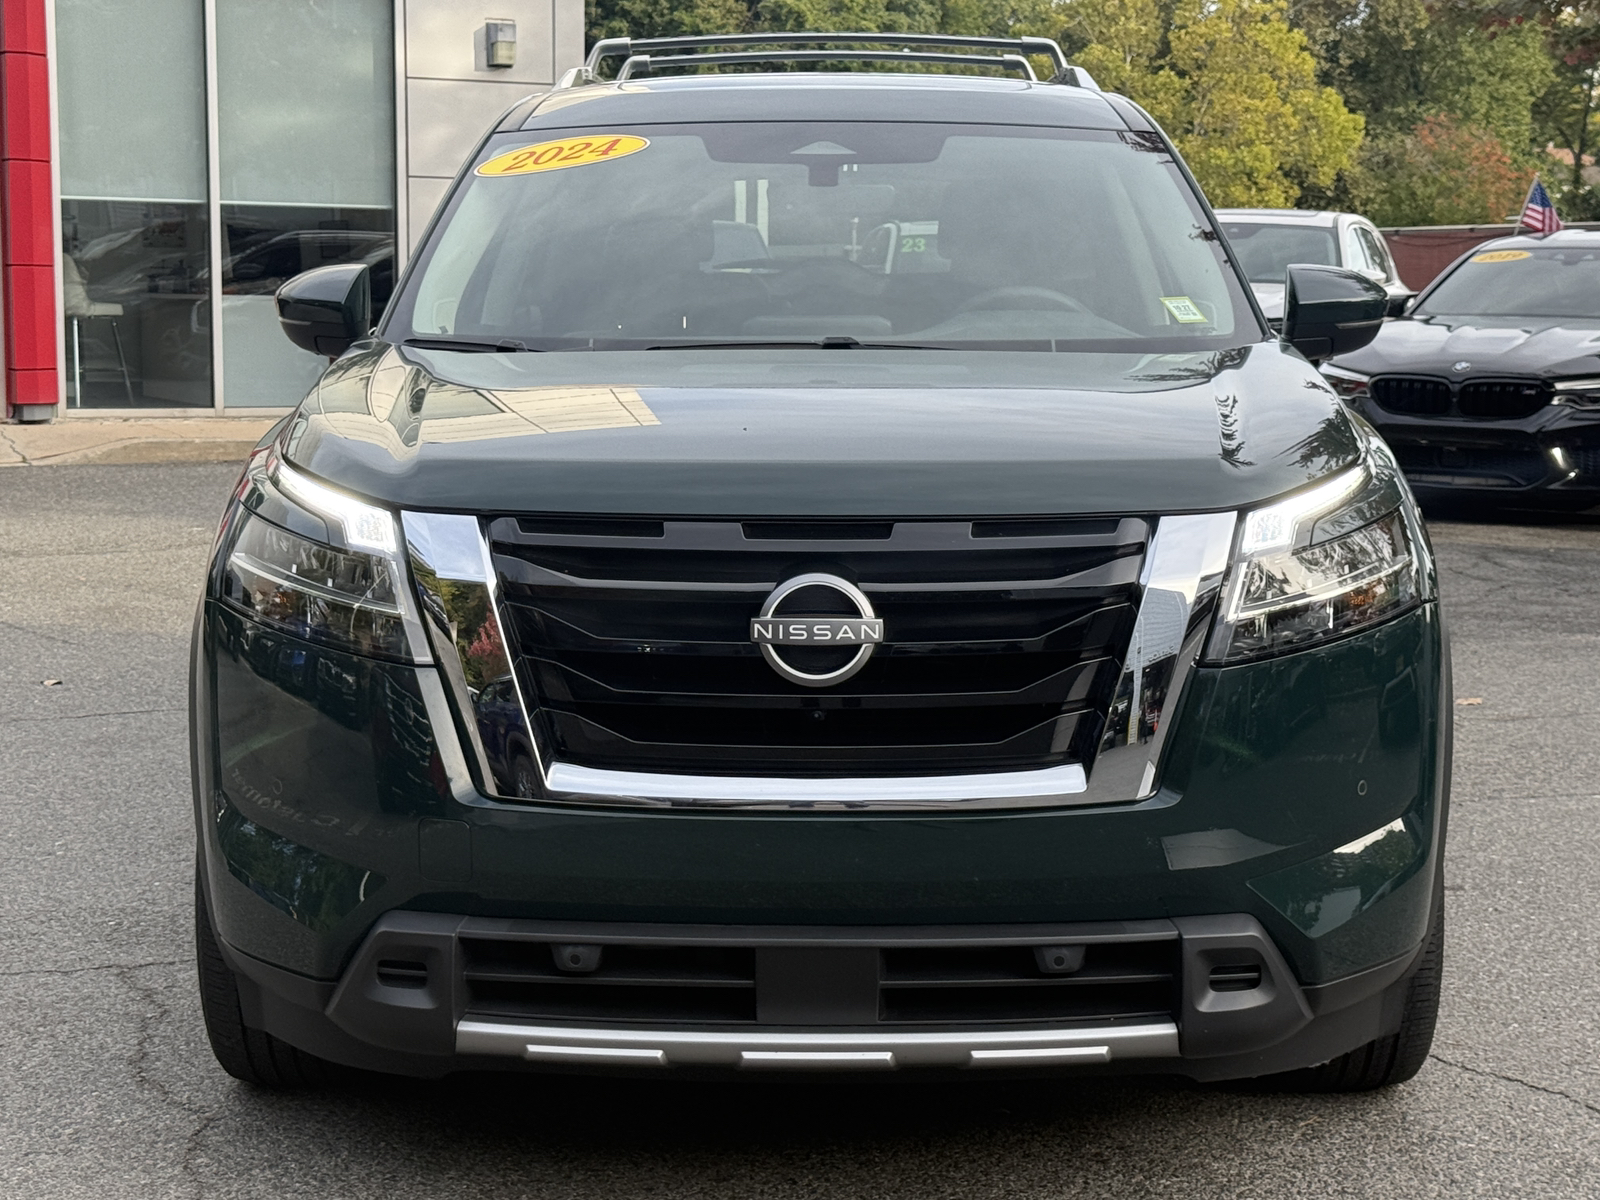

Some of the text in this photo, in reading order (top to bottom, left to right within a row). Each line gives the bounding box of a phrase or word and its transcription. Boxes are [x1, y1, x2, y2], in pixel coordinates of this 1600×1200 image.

[501, 138, 623, 173] 2024
[902, 237, 926, 253] 23
[753, 623, 880, 640] NISSAN
